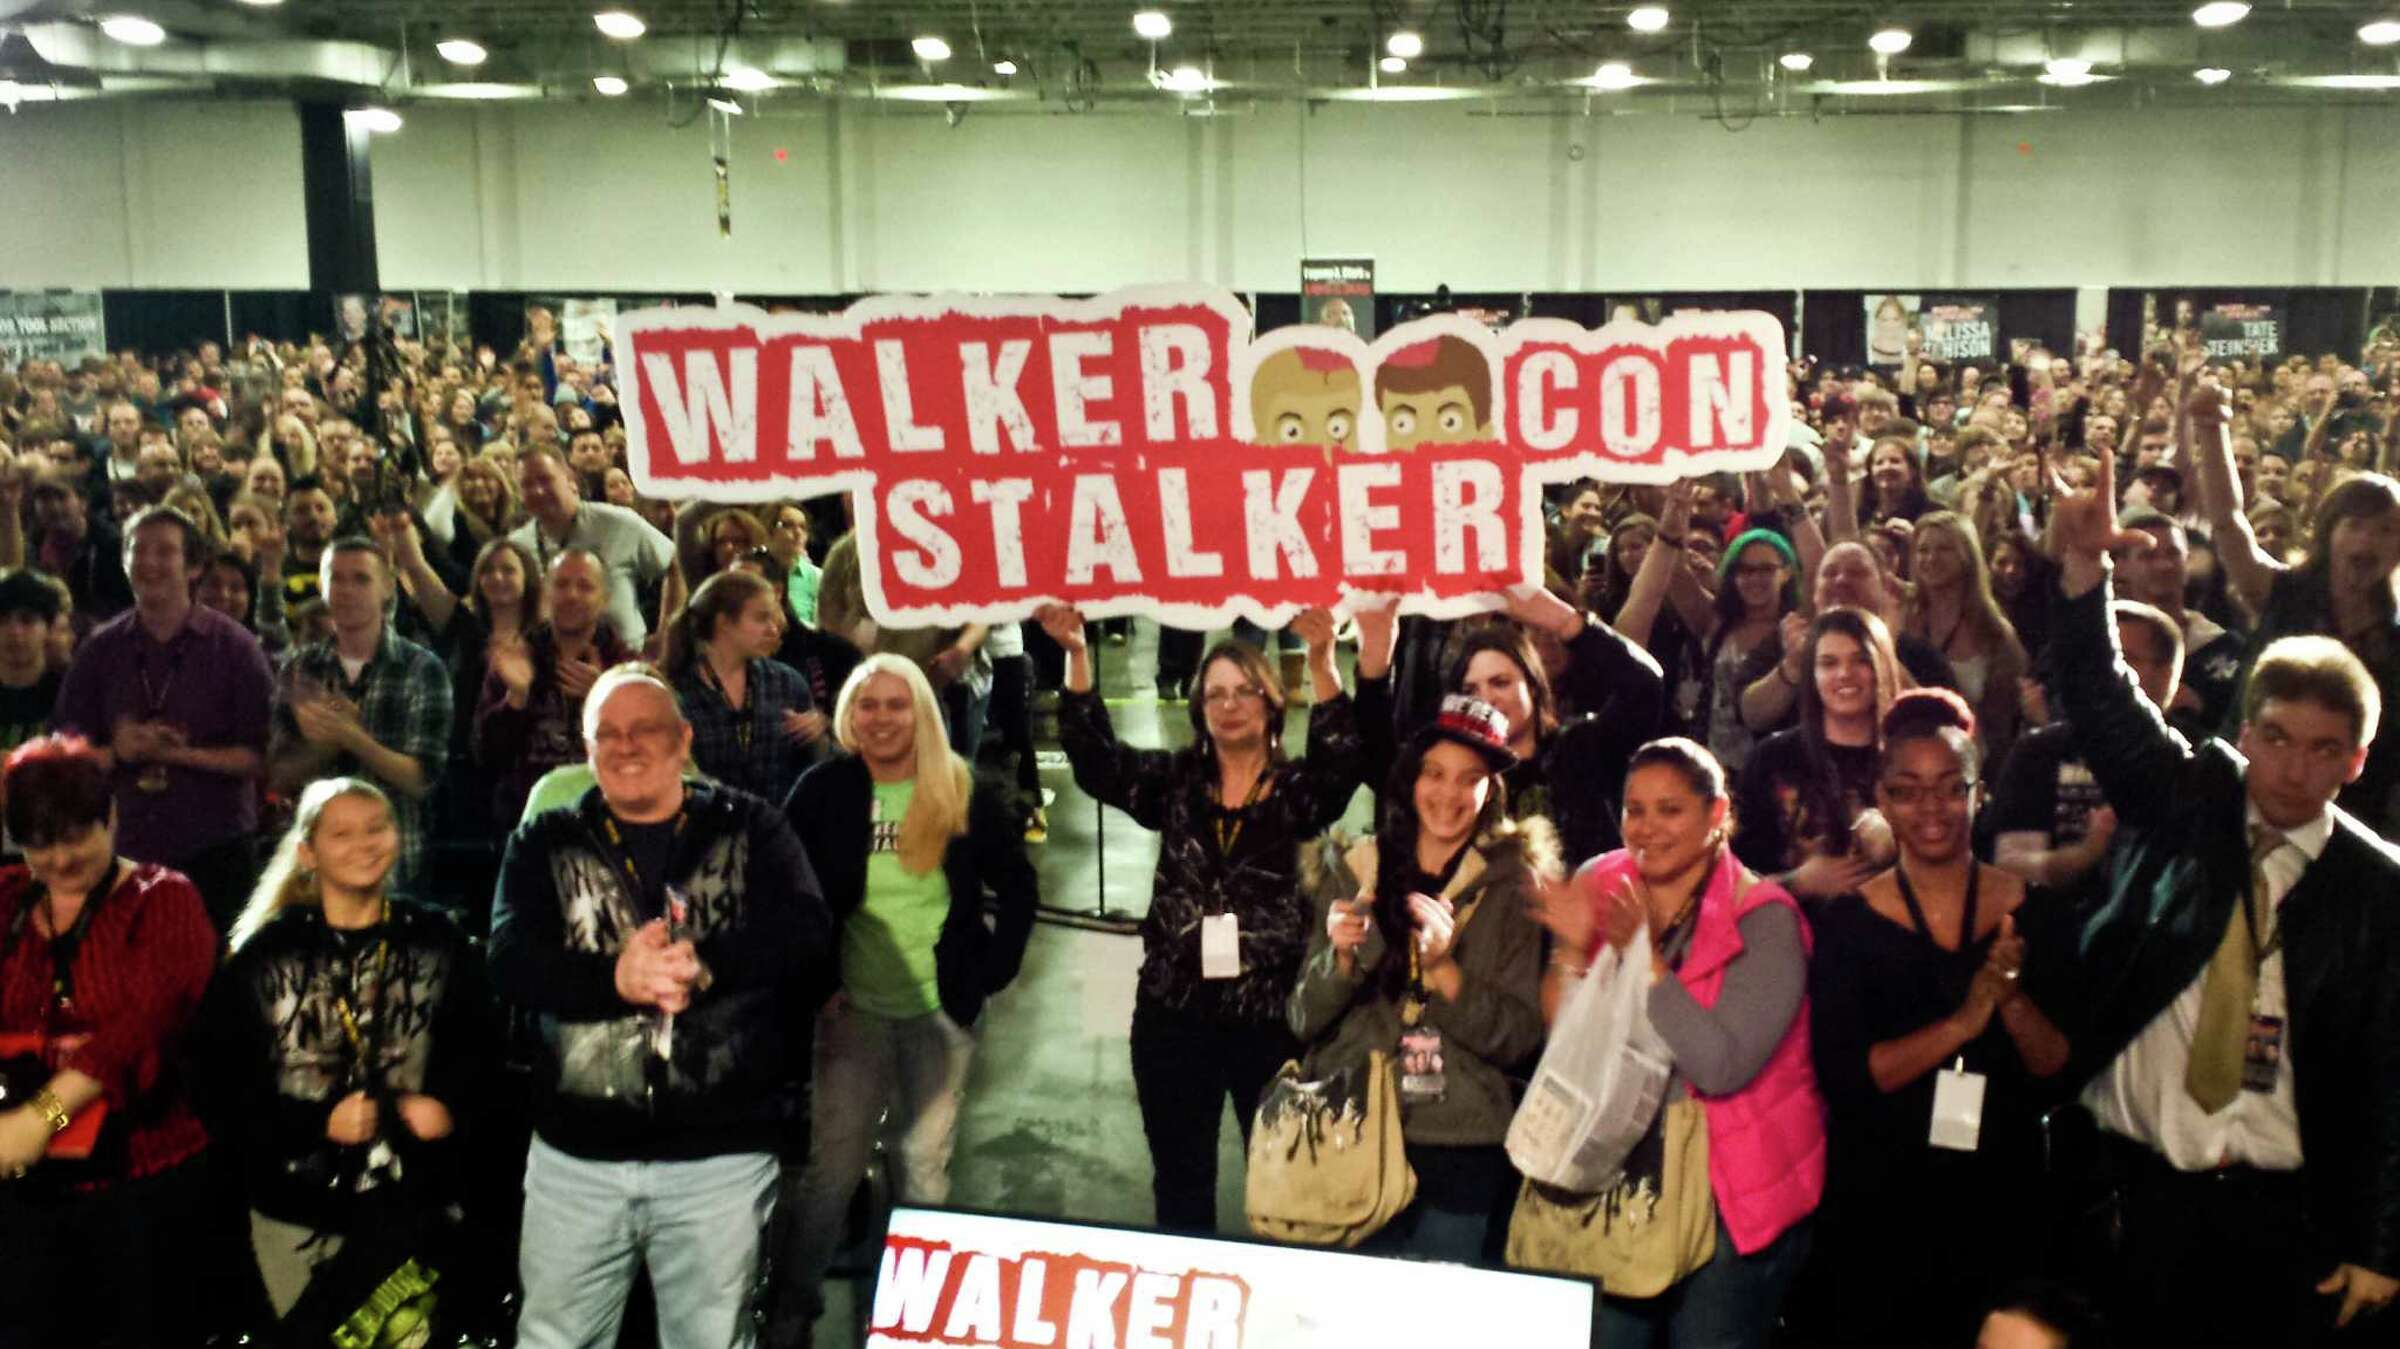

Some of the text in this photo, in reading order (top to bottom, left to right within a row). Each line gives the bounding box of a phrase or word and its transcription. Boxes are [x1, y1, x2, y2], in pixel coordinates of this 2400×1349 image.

[1924, 321, 1991, 340] MLISSA
[640, 323, 1217, 465] WALKER
[1518, 350, 1754, 456] CON
[885, 460, 1508, 589] STALKER
[871, 1245, 1244, 1349] WALKER
